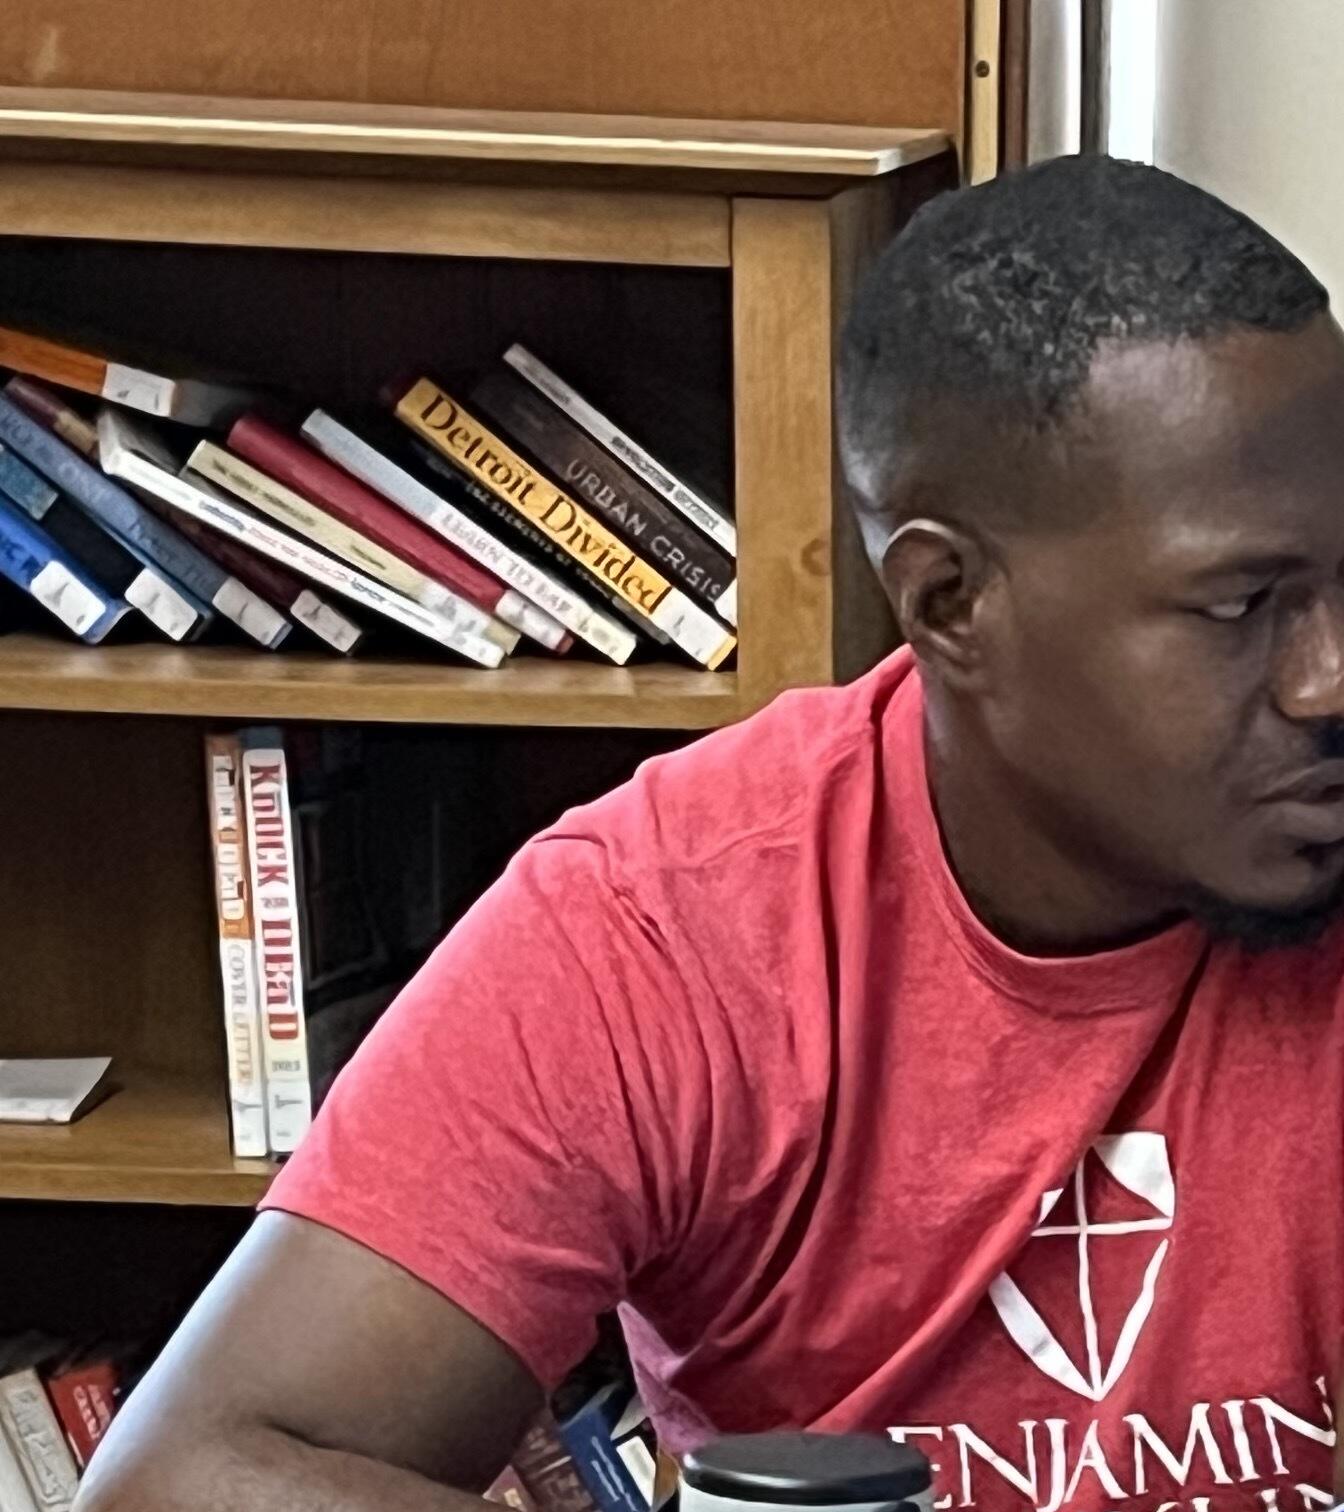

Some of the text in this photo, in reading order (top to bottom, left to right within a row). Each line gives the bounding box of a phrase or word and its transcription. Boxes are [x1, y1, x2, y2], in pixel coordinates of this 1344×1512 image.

[421, 393, 536, 506] Detroit
[539, 496, 674, 615] Divided
[567, 458, 647, 536] URBAN
[650, 534, 722, 602] CRISIS
